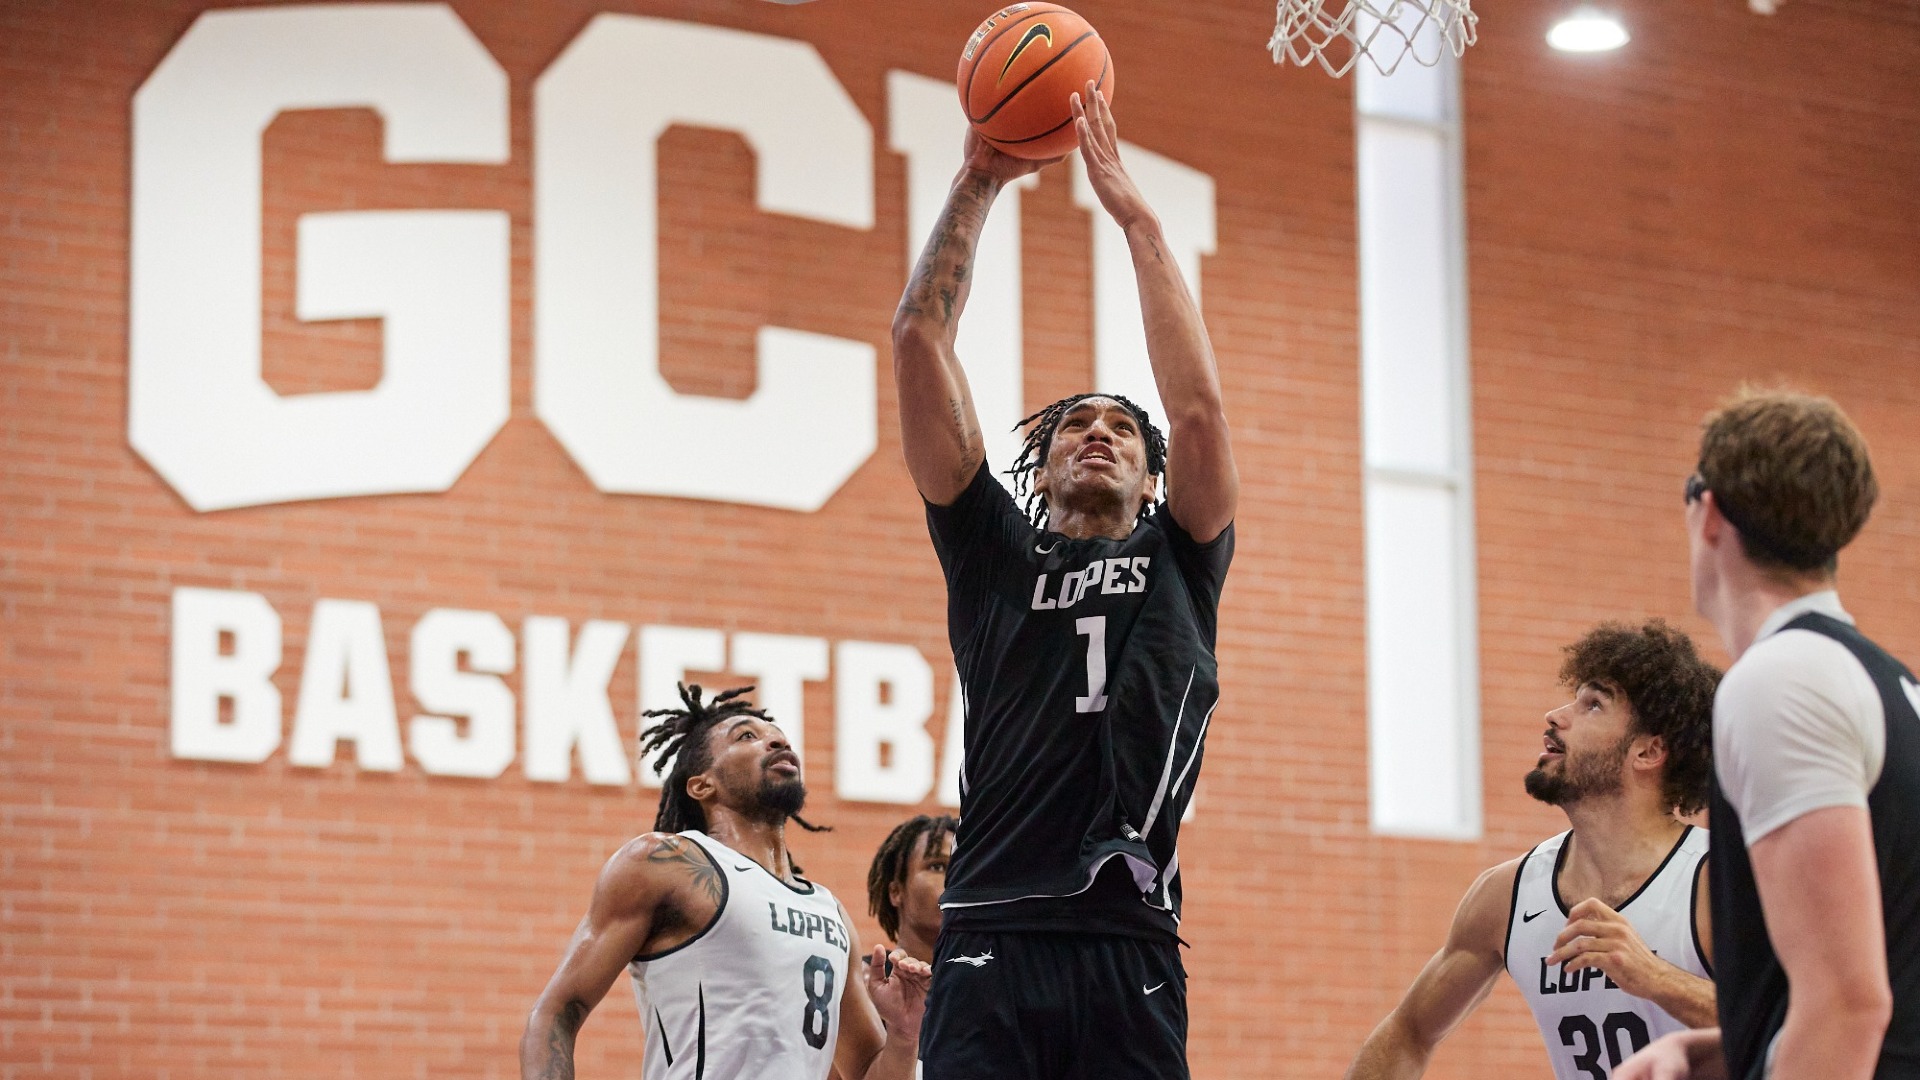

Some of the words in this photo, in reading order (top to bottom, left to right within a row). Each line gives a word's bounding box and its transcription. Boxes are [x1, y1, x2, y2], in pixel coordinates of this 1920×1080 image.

[1031, 556, 1150, 610] LOPES
[1075, 615, 1108, 713] 1
[768, 902, 848, 953] LOPES
[802, 954, 834, 1050] 8
